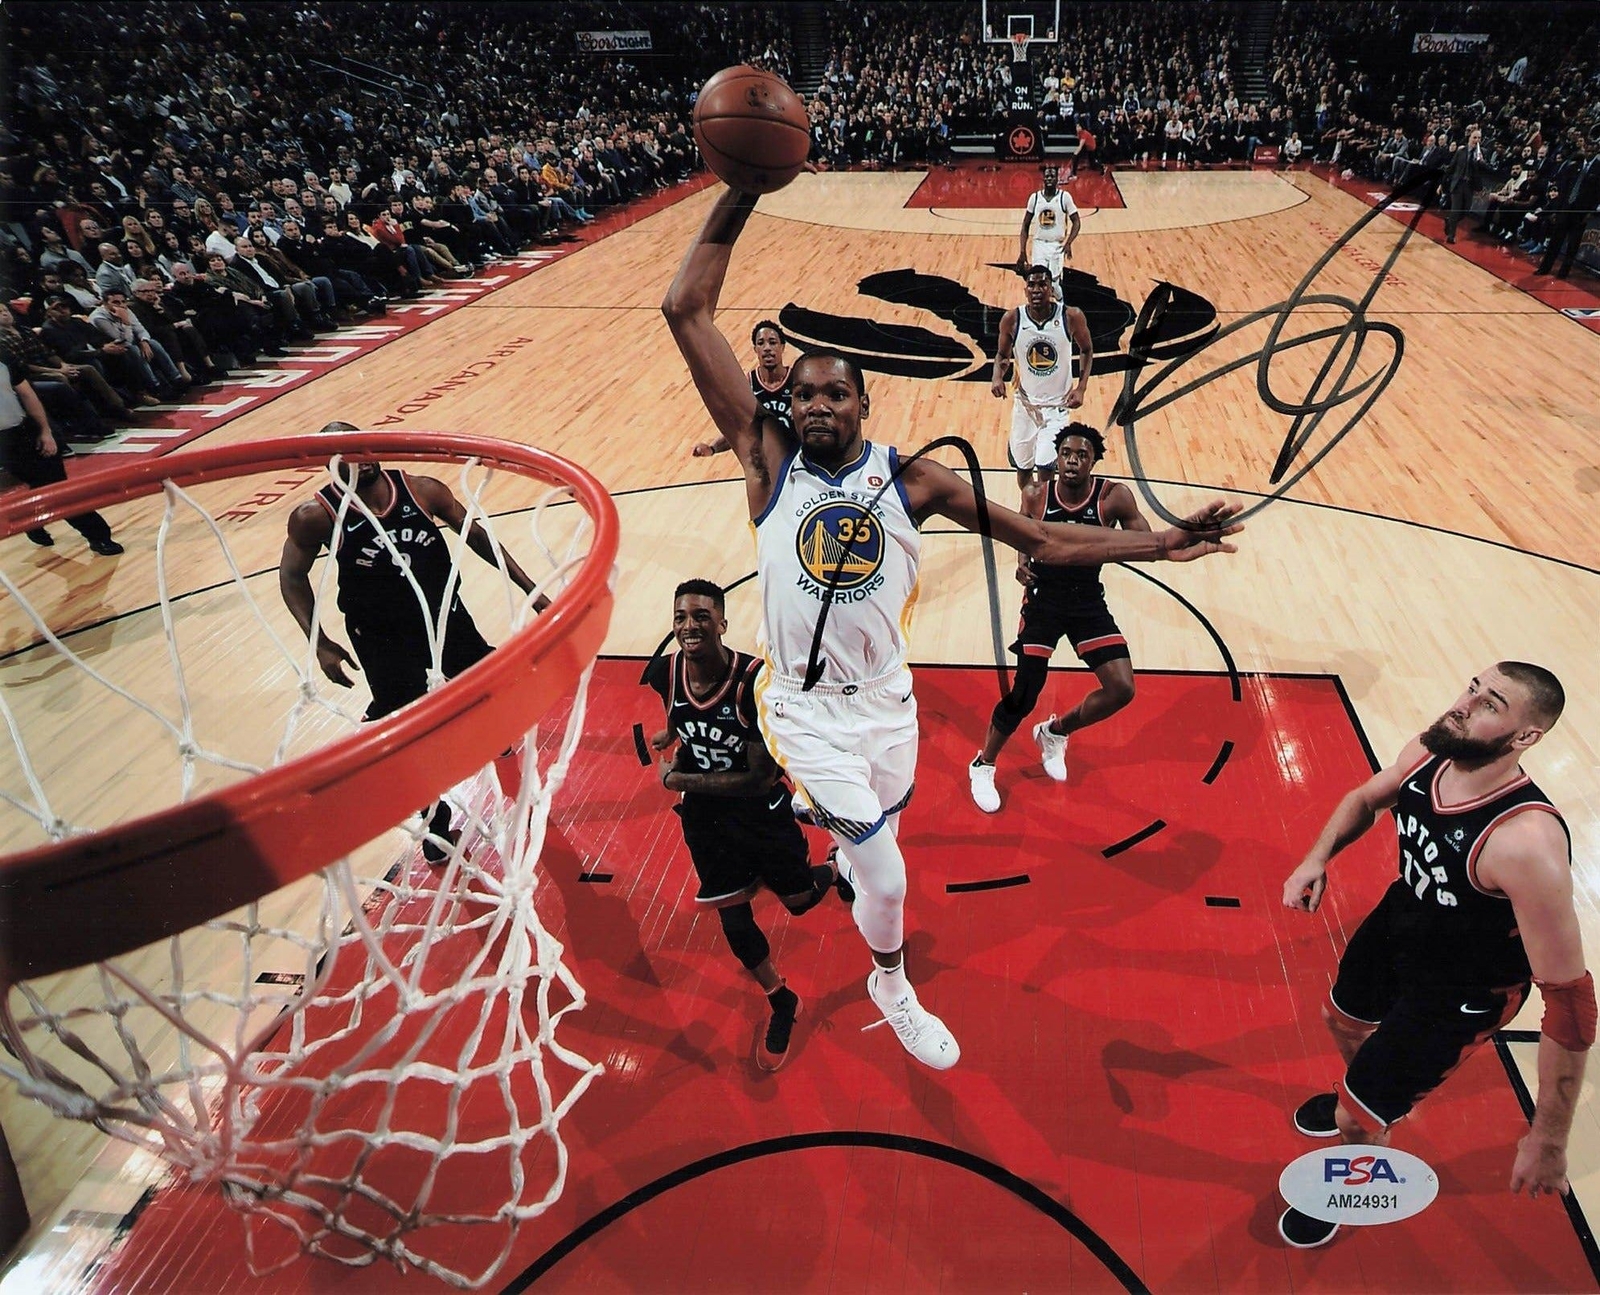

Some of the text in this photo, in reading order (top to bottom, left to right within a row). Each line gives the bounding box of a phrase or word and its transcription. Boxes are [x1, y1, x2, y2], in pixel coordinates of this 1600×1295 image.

[618, 36, 649, 49] LIGHT
[1014, 86, 1028, 95] ON
[1011, 102, 1033, 110] RUN.
[370, 360, 497, 427] CANADA
[795, 490, 886, 520] GOLDEN STATE
[838, 518, 871, 543] 35
[796, 573, 885, 605] WARRIORS
[691, 743, 733, 772] 55
[1397, 812, 1458, 907] APTORS
